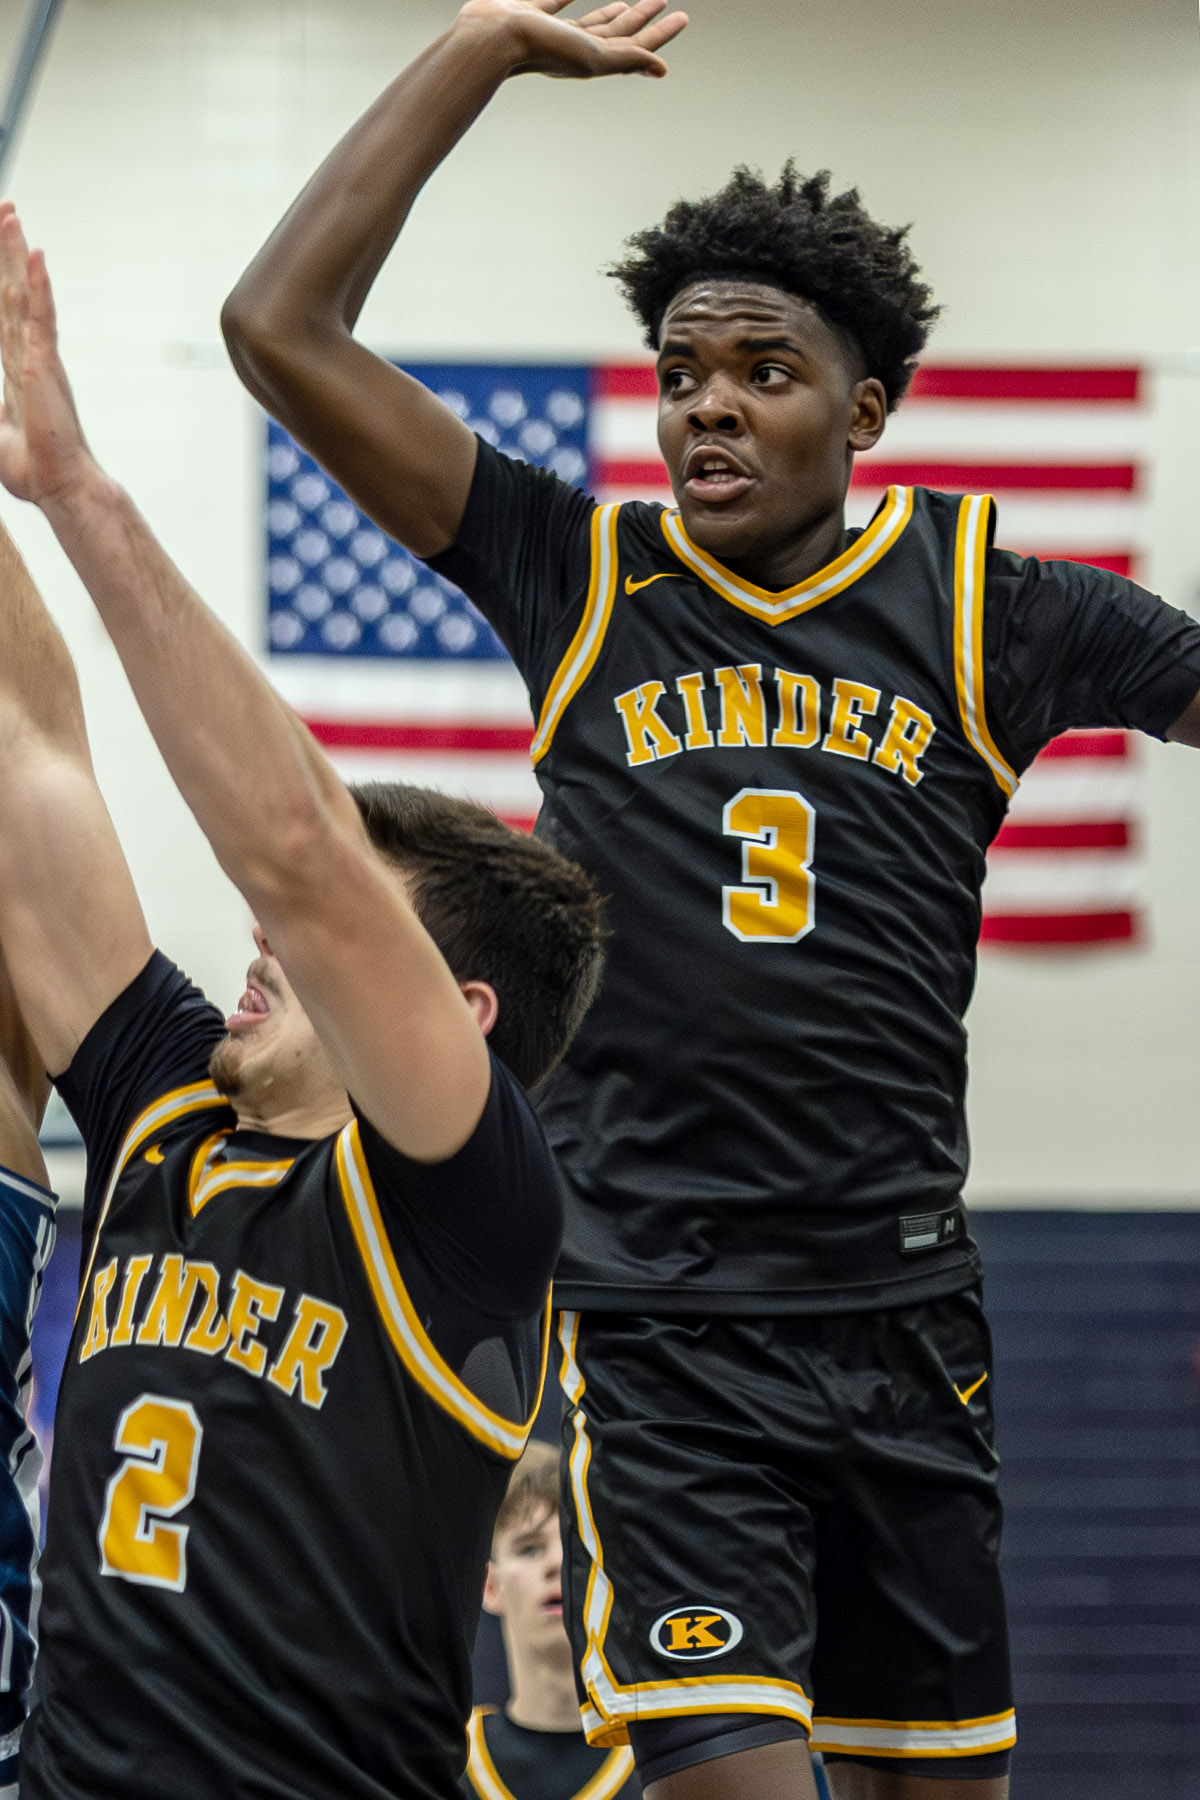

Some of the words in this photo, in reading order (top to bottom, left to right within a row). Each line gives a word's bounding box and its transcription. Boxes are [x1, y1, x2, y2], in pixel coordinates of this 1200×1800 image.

[614, 663, 937, 787] KINDER
[721, 787, 817, 944] 3
[78, 1252, 349, 1411] KINDER
[98, 1391, 204, 1594] 2
[665, 1614, 726, 1652] K
